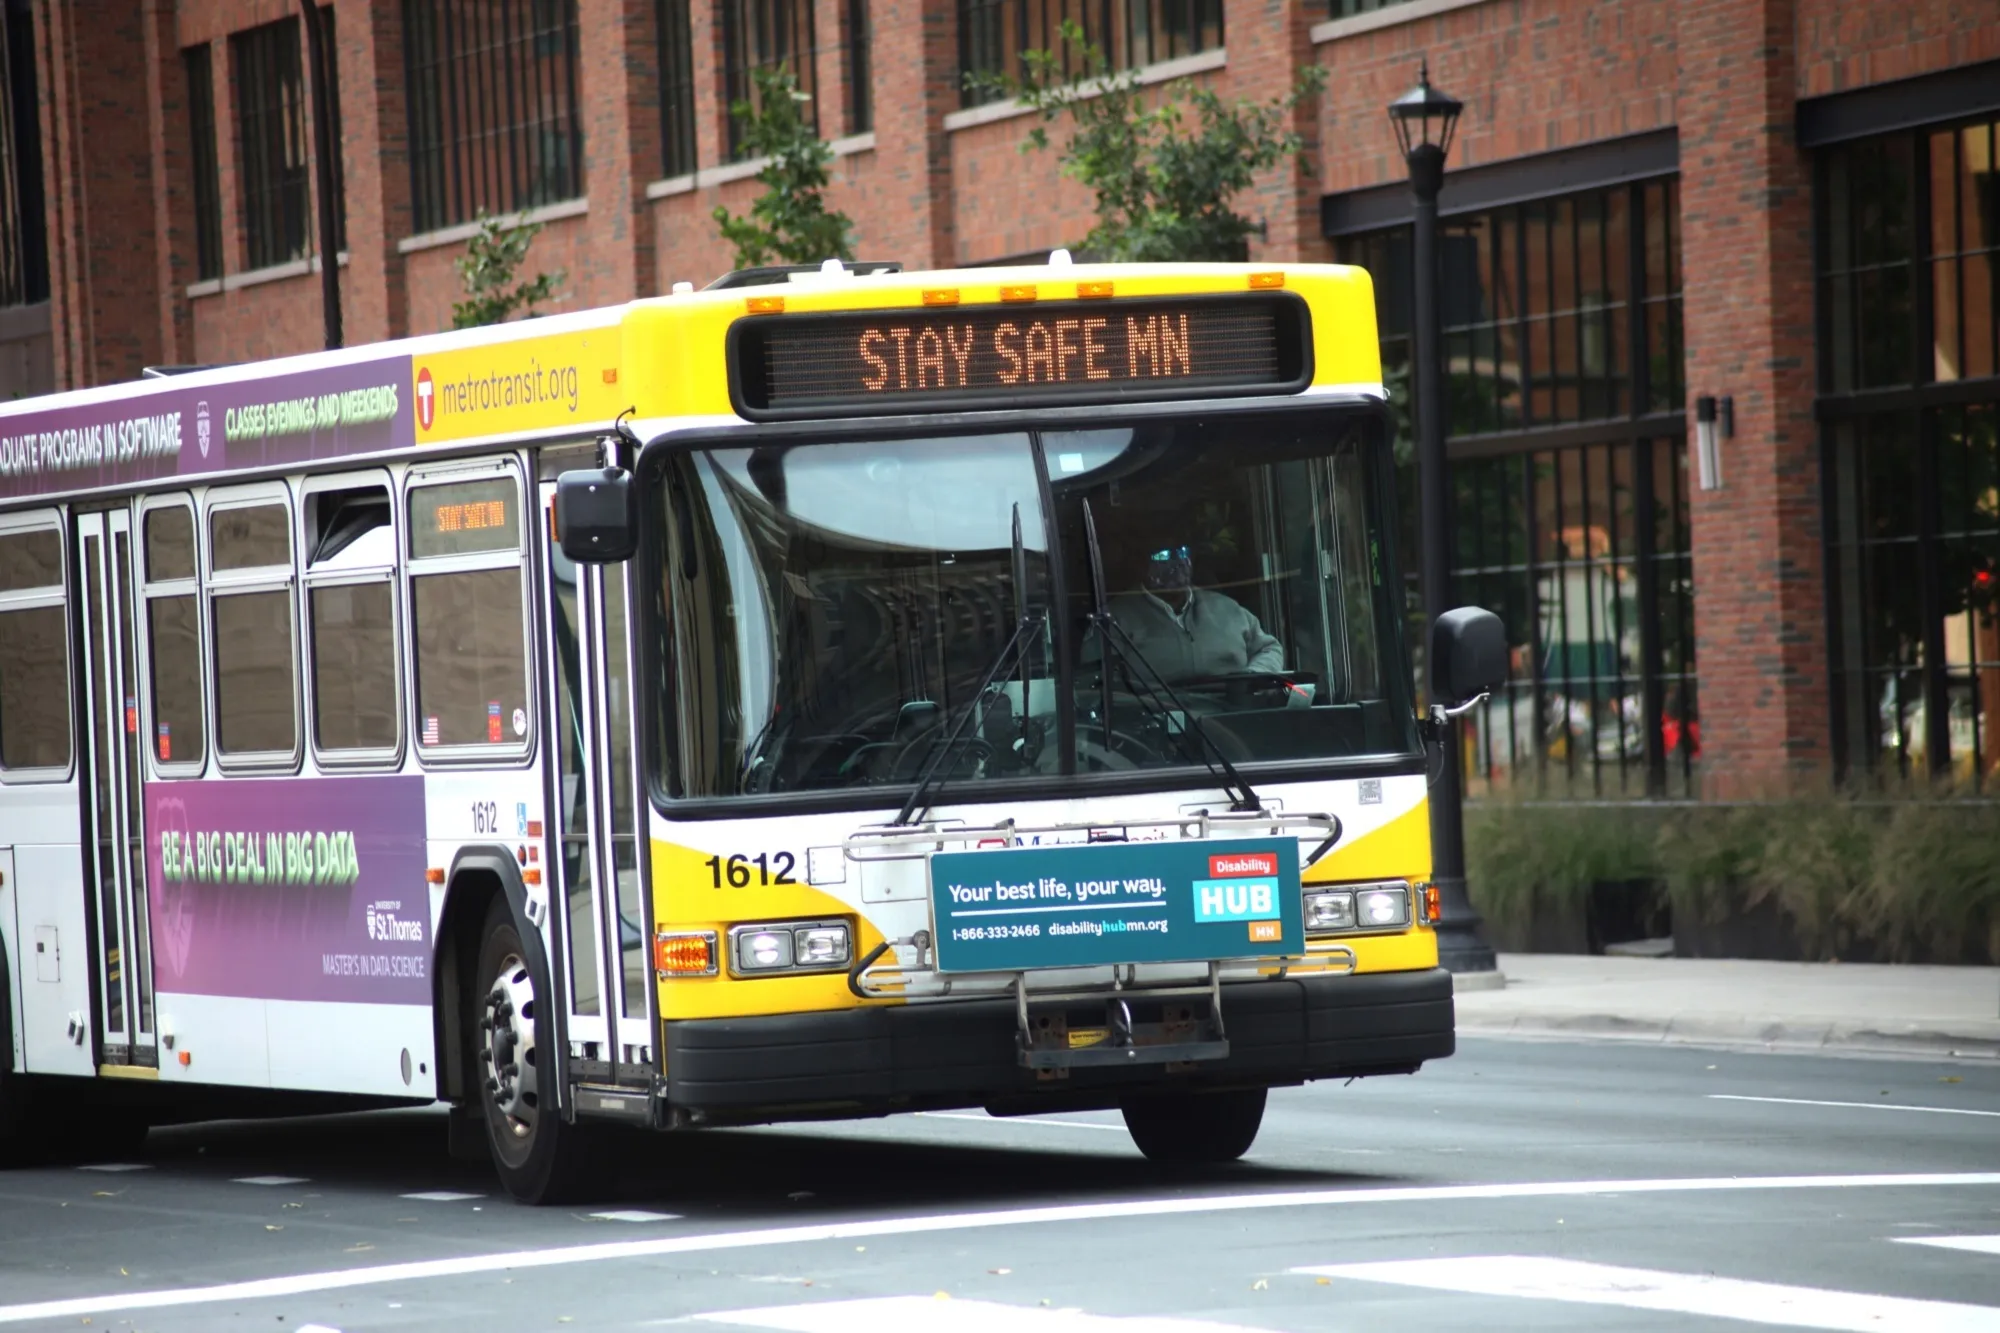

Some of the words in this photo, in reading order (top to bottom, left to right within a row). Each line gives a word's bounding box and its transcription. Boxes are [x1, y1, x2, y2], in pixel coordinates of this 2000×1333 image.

[859, 325, 974, 390] STAY
[994, 318, 1110, 384] SAFE
[1127, 314, 1190, 377] MN
[443, 358, 578, 414] metrotransit.org
[225, 404, 266, 438] CLASSES
[266, 397, 316, 434] EVENINGS
[316, 393, 340, 427] AND
[340, 384, 398, 424] WEEKENDS
[40, 424, 103, 470] PROGRAMS
[104, 422, 118, 458] IN
[119, 412, 183, 456] SOFTWARE
[472, 801, 498, 833] 1612
[162, 831, 182, 880] BE
[183, 831, 196, 879] A
[196, 831, 222, 880] BIG
[225, 832, 265, 880] DEAL
[266, 832, 284, 880] IN
[286, 831, 314, 880] BIG
[314, 831, 359, 880] DATA
[705, 851, 796, 889] 1612
[1216, 859, 1271, 874] Disability
[949, 884, 992, 903] Your
[996, 880, 1036, 901] best
[1039, 878, 1071, 901] life,
[1075, 879, 1119, 902] your
[1123, 878, 1167, 898] way.
[1201, 884, 1273, 915] HUB
[952, 924, 1041, 941] 1-866-333-2466
[1049, 919, 1168, 936] disabilityhubmn.org
[1255, 926, 1275, 938] MN
[322, 954, 359, 976] MASTER'S
[360, 955, 370, 976] IN
[370, 955, 391, 976] DATA
[391, 955, 425, 978] SCIENCE
